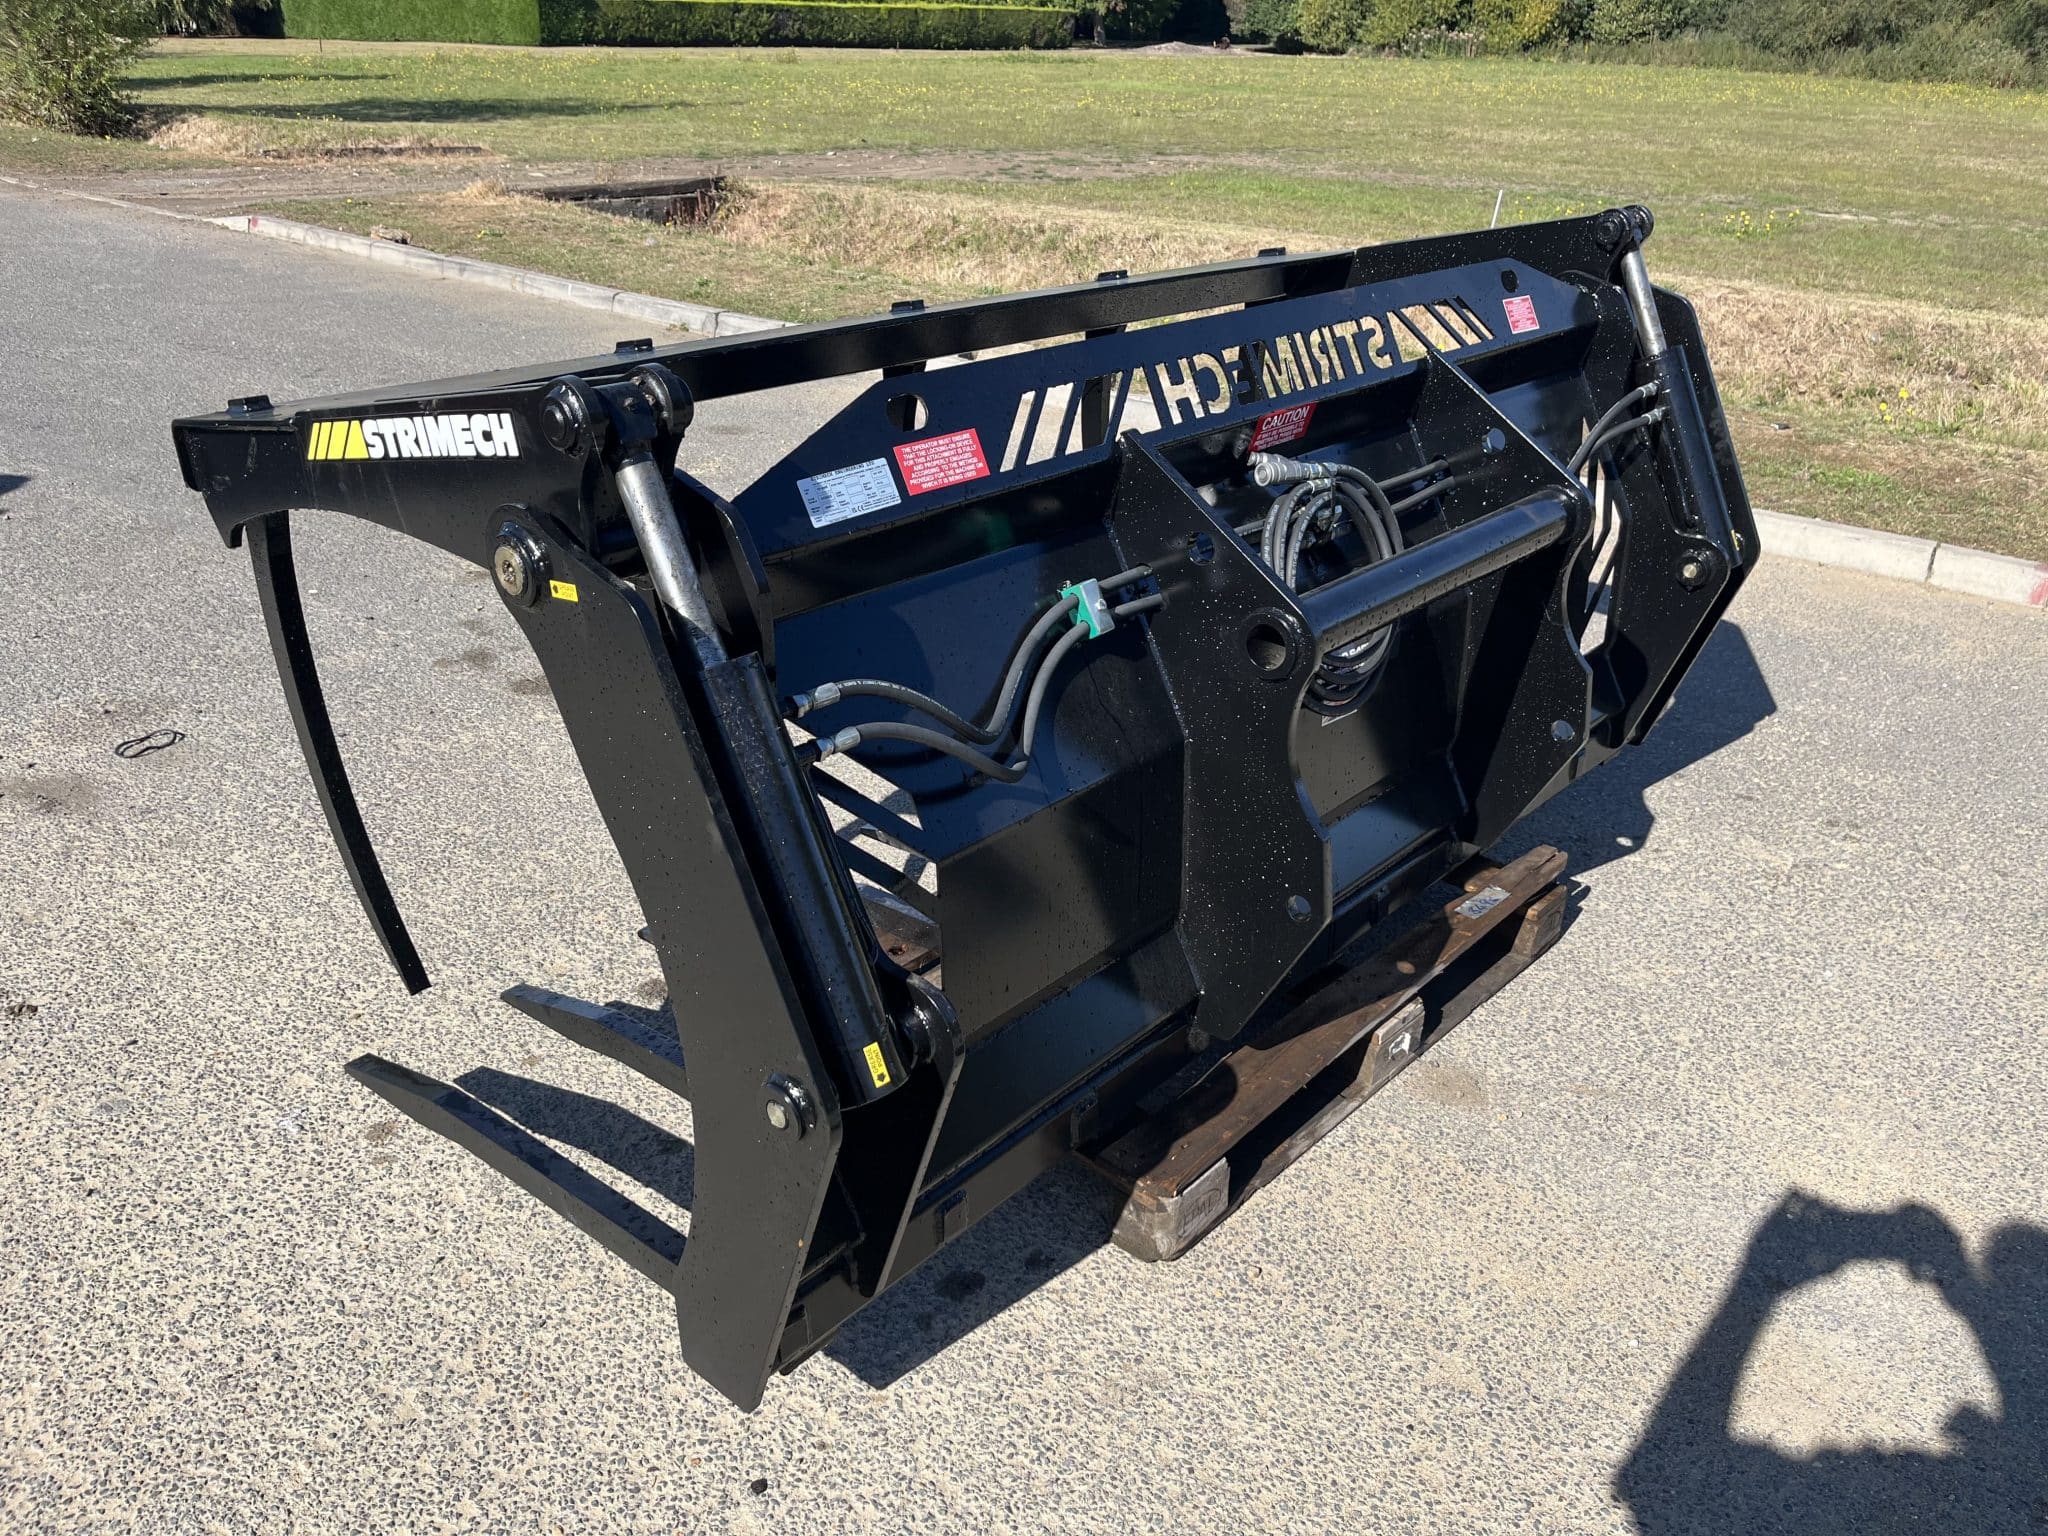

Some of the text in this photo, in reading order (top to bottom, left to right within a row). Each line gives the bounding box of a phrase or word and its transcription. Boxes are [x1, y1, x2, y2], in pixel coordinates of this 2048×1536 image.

[1262, 405, 1310, 431] CAUTION
[362, 413, 519, 459] STRIMECH
[912, 441, 937, 451] OPERATOR
[952, 433, 970, 441] ENSURE
[926, 449, 957, 461] ATTACHMENT
[962, 444, 976, 452] FULLY
[927, 443, 956, 454] LOCKING-ON
[956, 439, 973, 447] DEVICE
[911, 467, 940, 478] ACCORDING
[958, 457, 978, 466] METHOD
[924, 458, 949, 468] PROPERLY
[950, 452, 972, 461] ENGAGED
[910, 475, 934, 485] PROVIDED
[955, 464, 976, 473] MACHINE
[921, 481, 938, 489] WHICH
[949, 474, 963, 482] BEING
[964, 470, 976, 478] USED
[866, 1048, 879, 1074] GREASE
[873, 1049, 883, 1068] POINT
